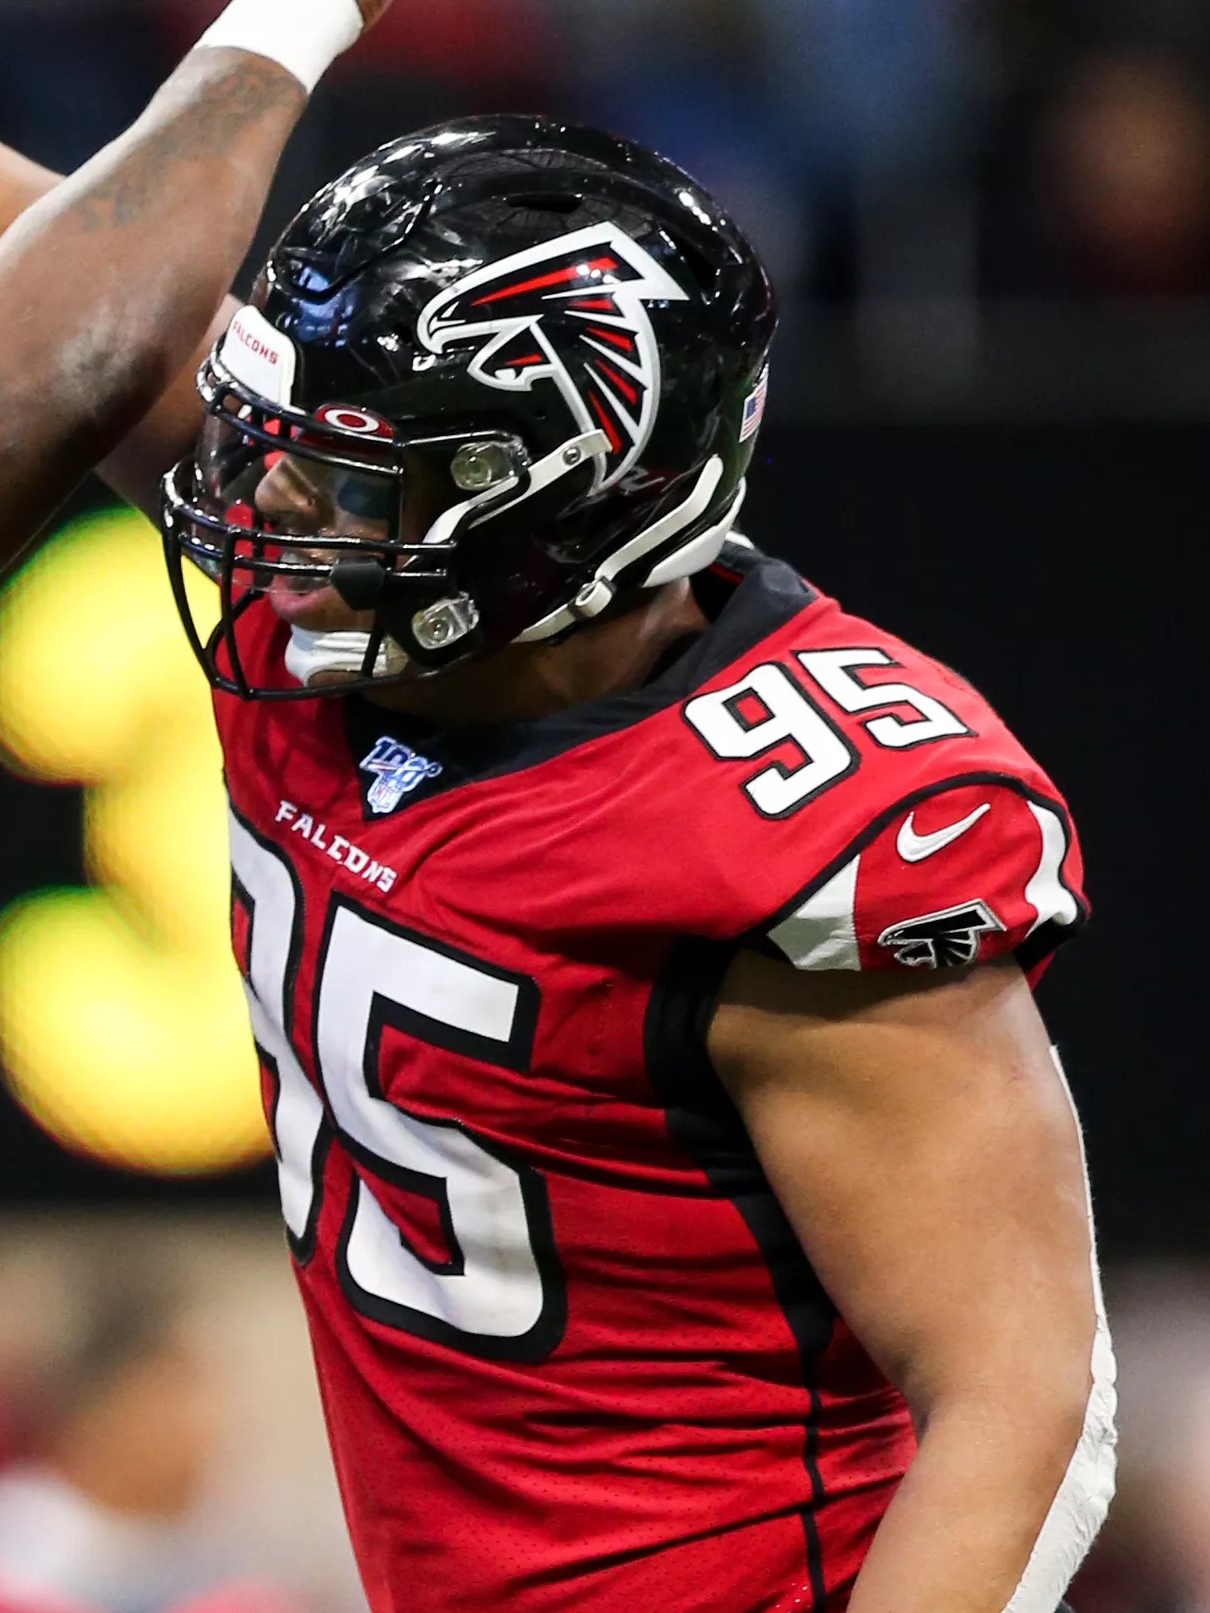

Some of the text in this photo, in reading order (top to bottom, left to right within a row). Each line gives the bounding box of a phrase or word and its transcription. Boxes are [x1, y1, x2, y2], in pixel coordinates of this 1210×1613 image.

[232, 320, 280, 365] FALCONS
[682, 648, 978, 819] 95
[274, 799, 397, 893] FALCONS
[227, 803, 568, 1363] 95
